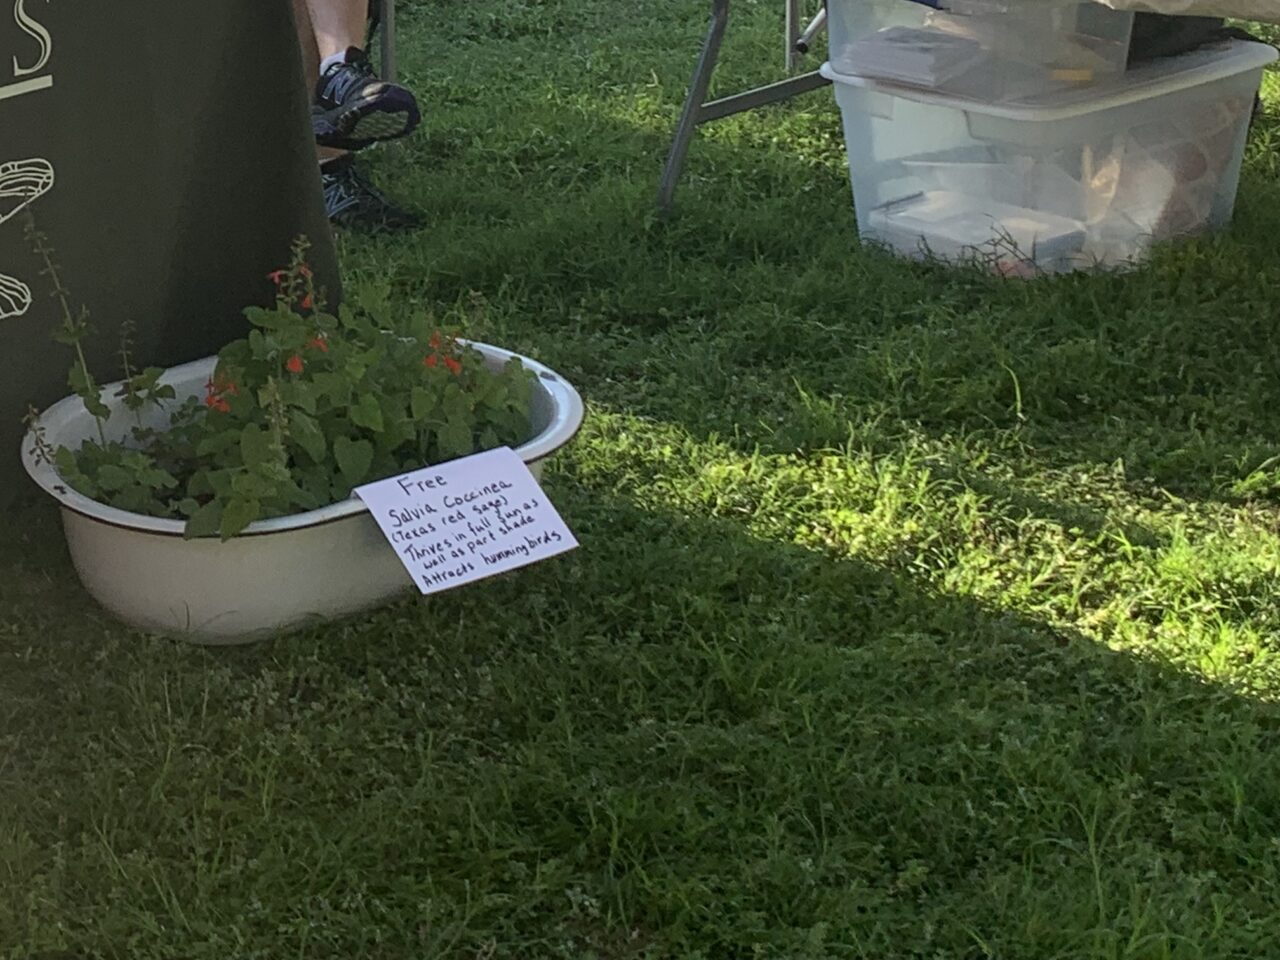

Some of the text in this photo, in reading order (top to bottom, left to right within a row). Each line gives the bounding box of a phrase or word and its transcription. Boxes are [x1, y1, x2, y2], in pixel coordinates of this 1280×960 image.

[388, 480, 513, 527] Salvia Coccinea
[397, 475, 447, 496] Free
[392, 523, 436, 543] (Texas
[441, 512, 466, 527] red
[404, 540, 452, 562] Thrives
[454, 530, 467, 542] in
[468, 516, 491, 537] full
[523, 499, 539, 510] as
[451, 548, 465, 559] as
[467, 533, 497, 553] part
[499, 515, 535, 536] shade
[422, 561, 475, 588] Attracts
